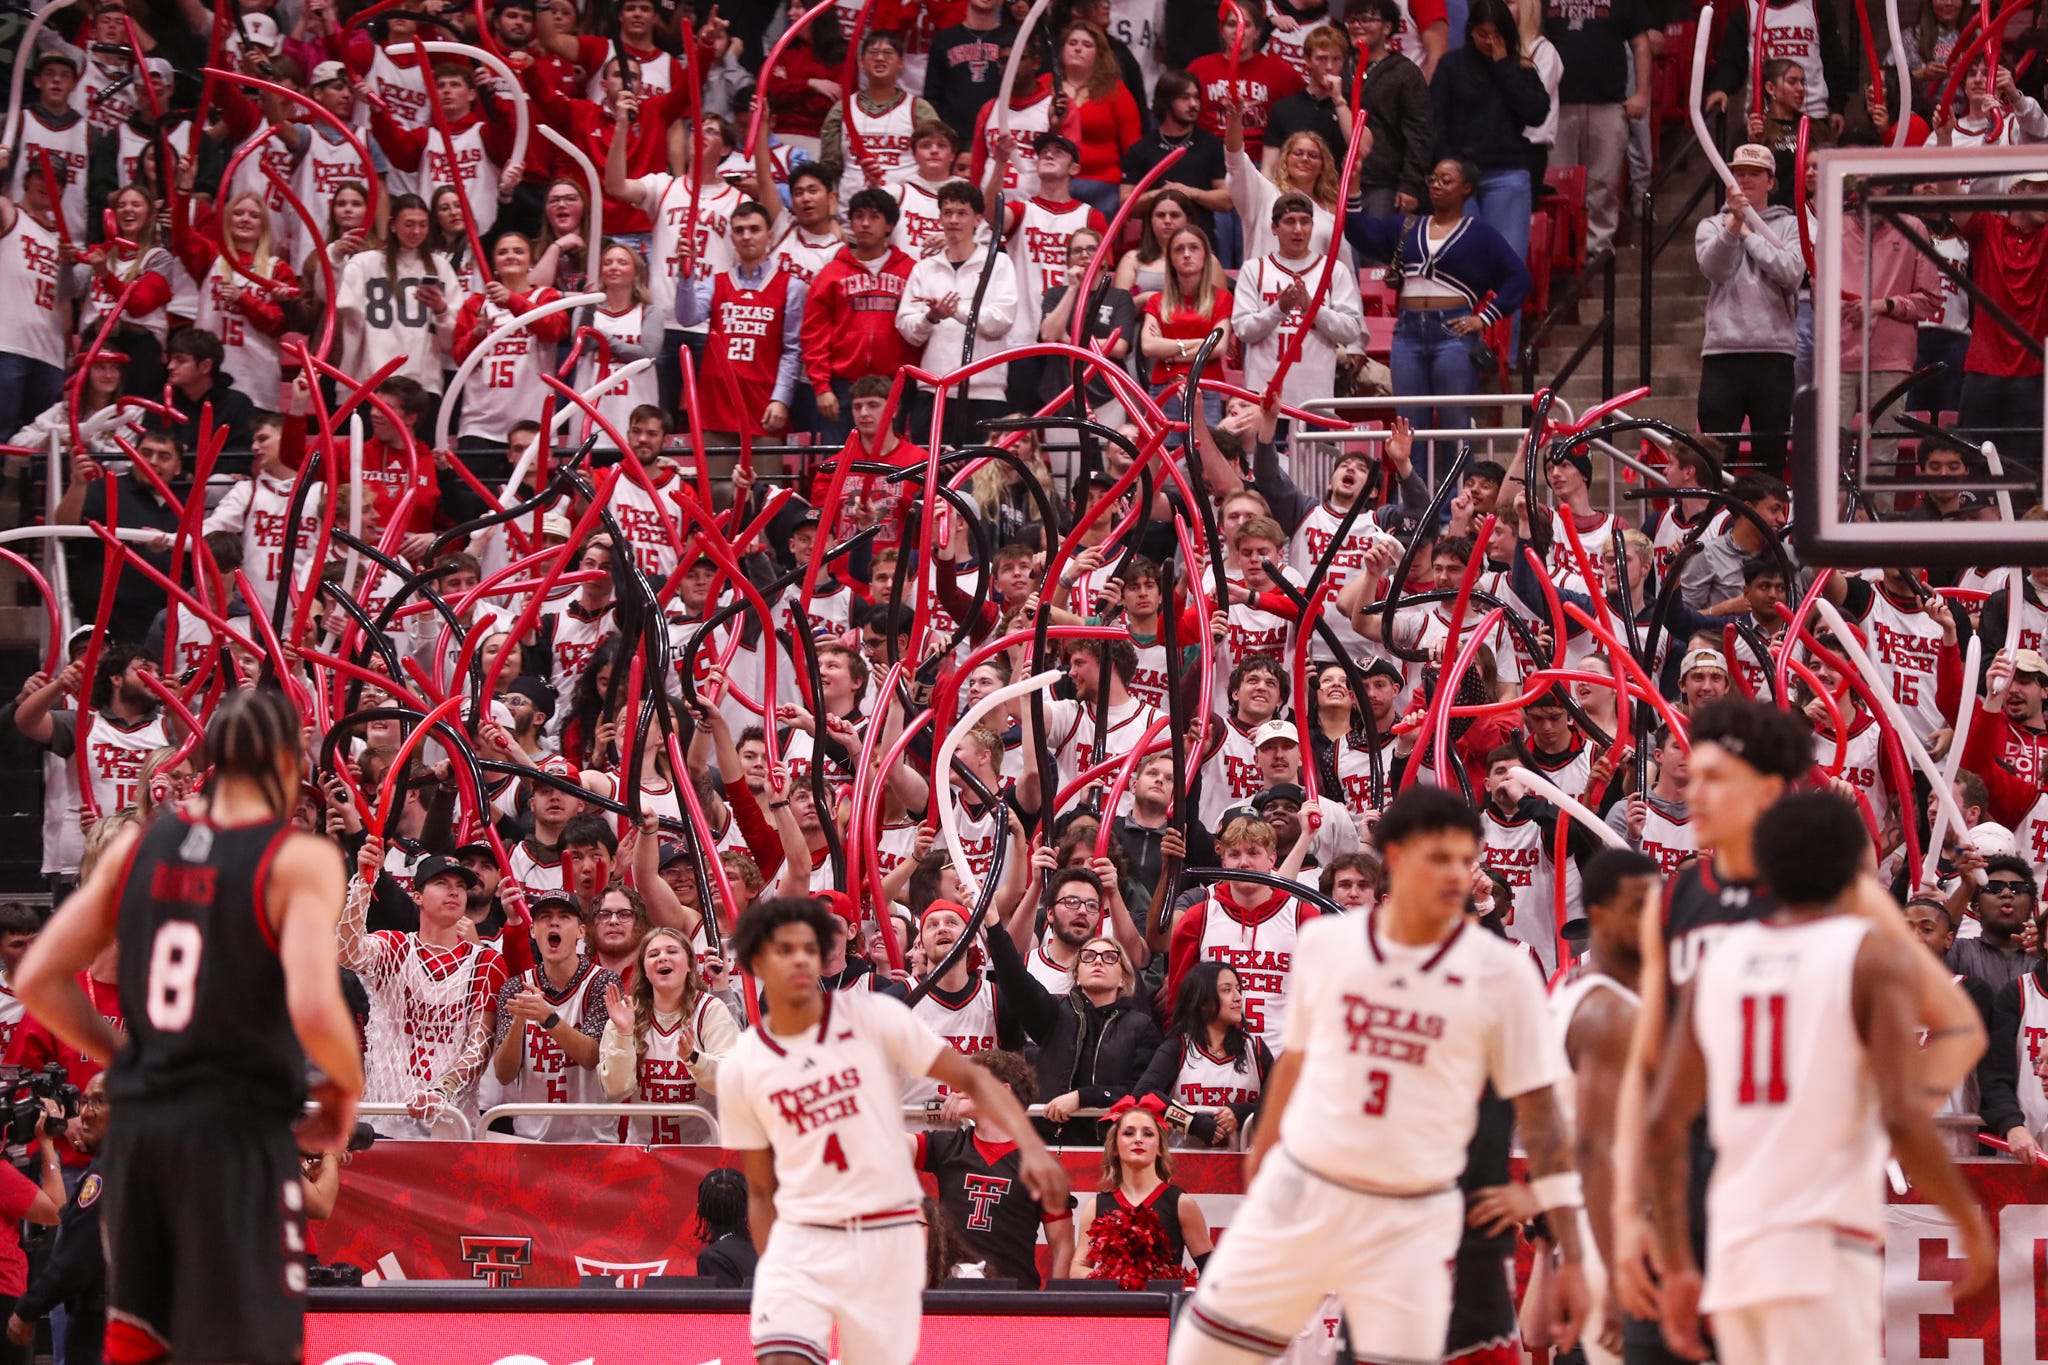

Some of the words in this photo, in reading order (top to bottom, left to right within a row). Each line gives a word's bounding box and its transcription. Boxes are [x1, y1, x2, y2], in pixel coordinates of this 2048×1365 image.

[366, 277, 427, 330] 80
[720, 302, 775, 321] TEXAS
[723, 318, 768, 337] TECH
[728, 337, 756, 361] 23
[489, 361, 515, 389] 15
[362, 470, 398, 484] TEXAS
[1228, 624, 1288, 647] TEXAS
[1874, 621, 1943, 656] TEXAS
[1880, 646, 1934, 674] TECH
[1893, 671, 1920, 707] 15
[147, 918, 202, 1032] 8
[1209, 945, 1292, 973] TEXAS
[1240, 971, 1284, 995] ECH
[1342, 993, 1446, 1040] TEXAS
[1348, 1030, 1428, 1067] TECH
[1737, 993, 1790, 1106] 11
[769, 1067, 862, 1121] TEXAS
[1181, 1083, 1259, 1107] TEXAS
[1363, 1069, 1391, 1117] 3
[786, 1095, 862, 1137] TECH
[822, 1131, 850, 1174] 4
